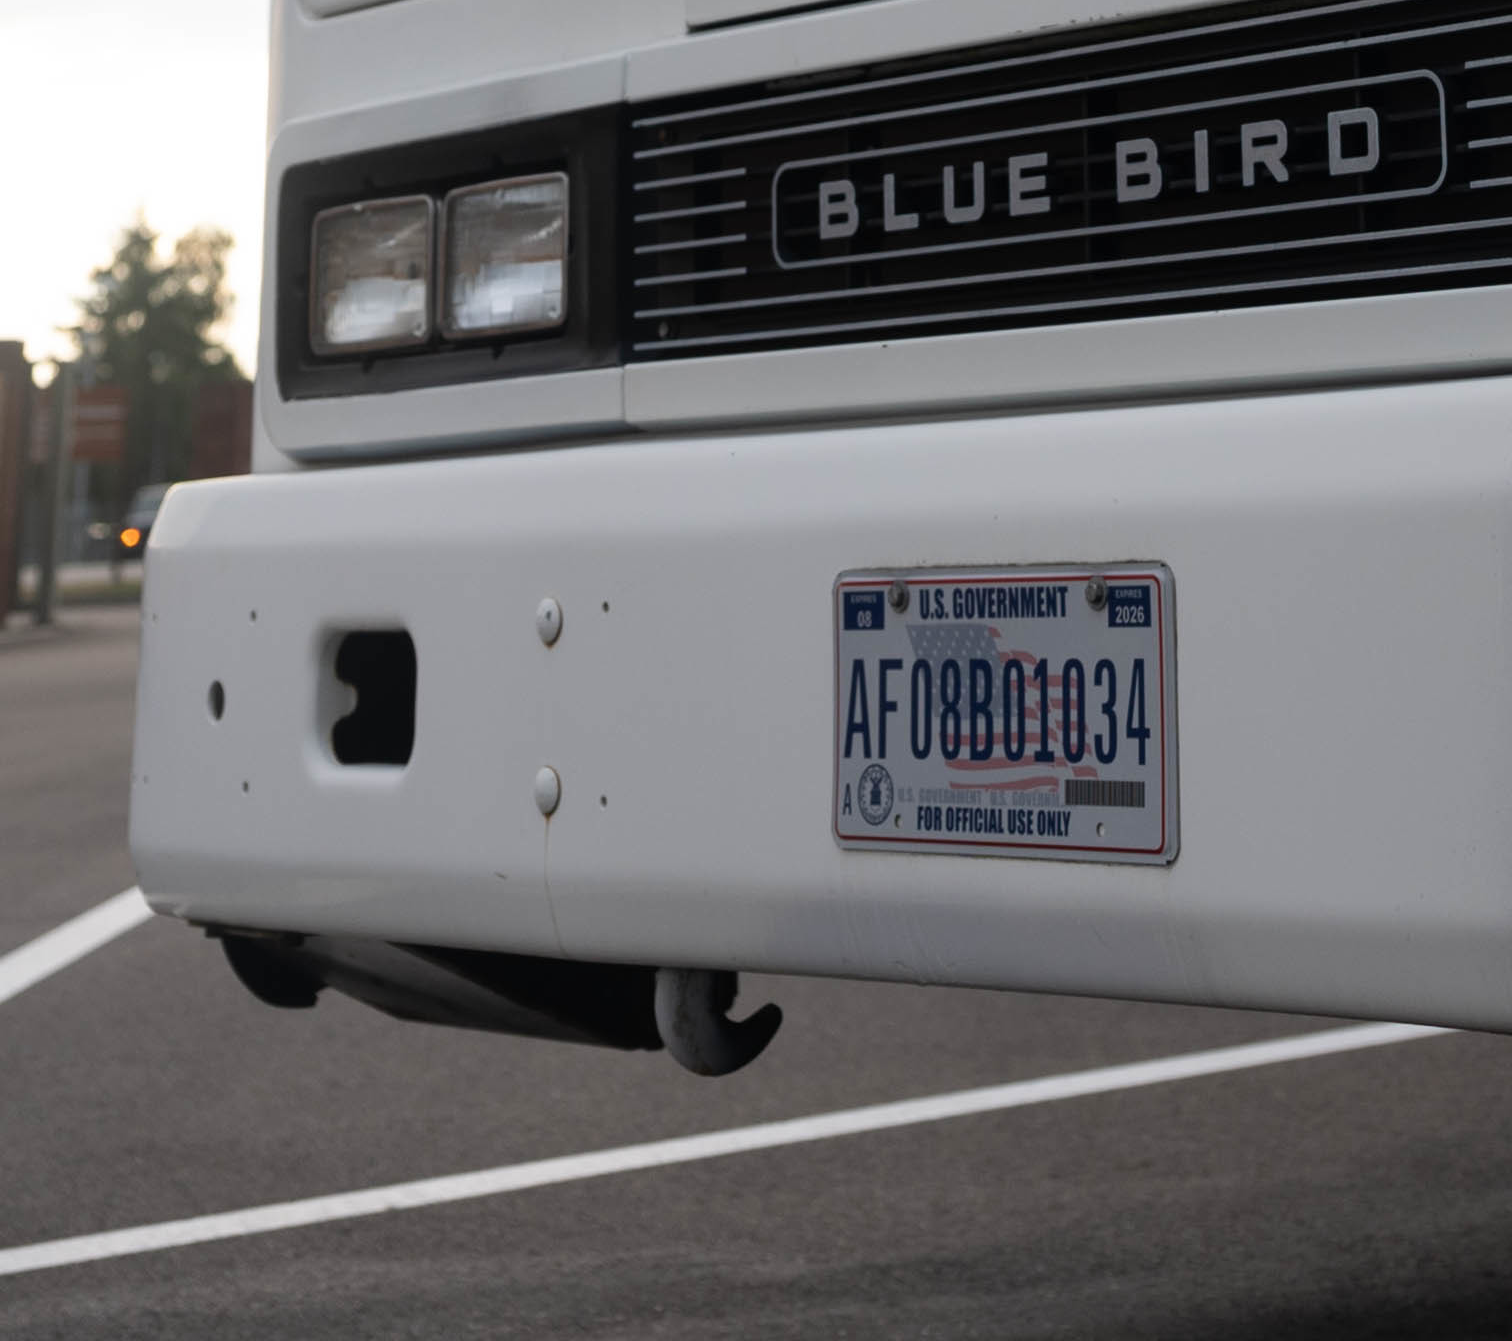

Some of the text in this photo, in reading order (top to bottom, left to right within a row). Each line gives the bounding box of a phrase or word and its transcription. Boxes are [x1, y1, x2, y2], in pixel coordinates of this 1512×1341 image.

[818, 107, 1380, 240] BLUE BIRD
[857, 609, 873, 628] 08
[919, 586, 1068, 620] U.S. GOVERNMENT
[1114, 605, 1145, 624] 2026
[844, 658, 1151, 765] AF08B01034
[843, 783, 852, 815] A
[917, 806, 1071, 837] FOR OFFICIAL USE ONLY
